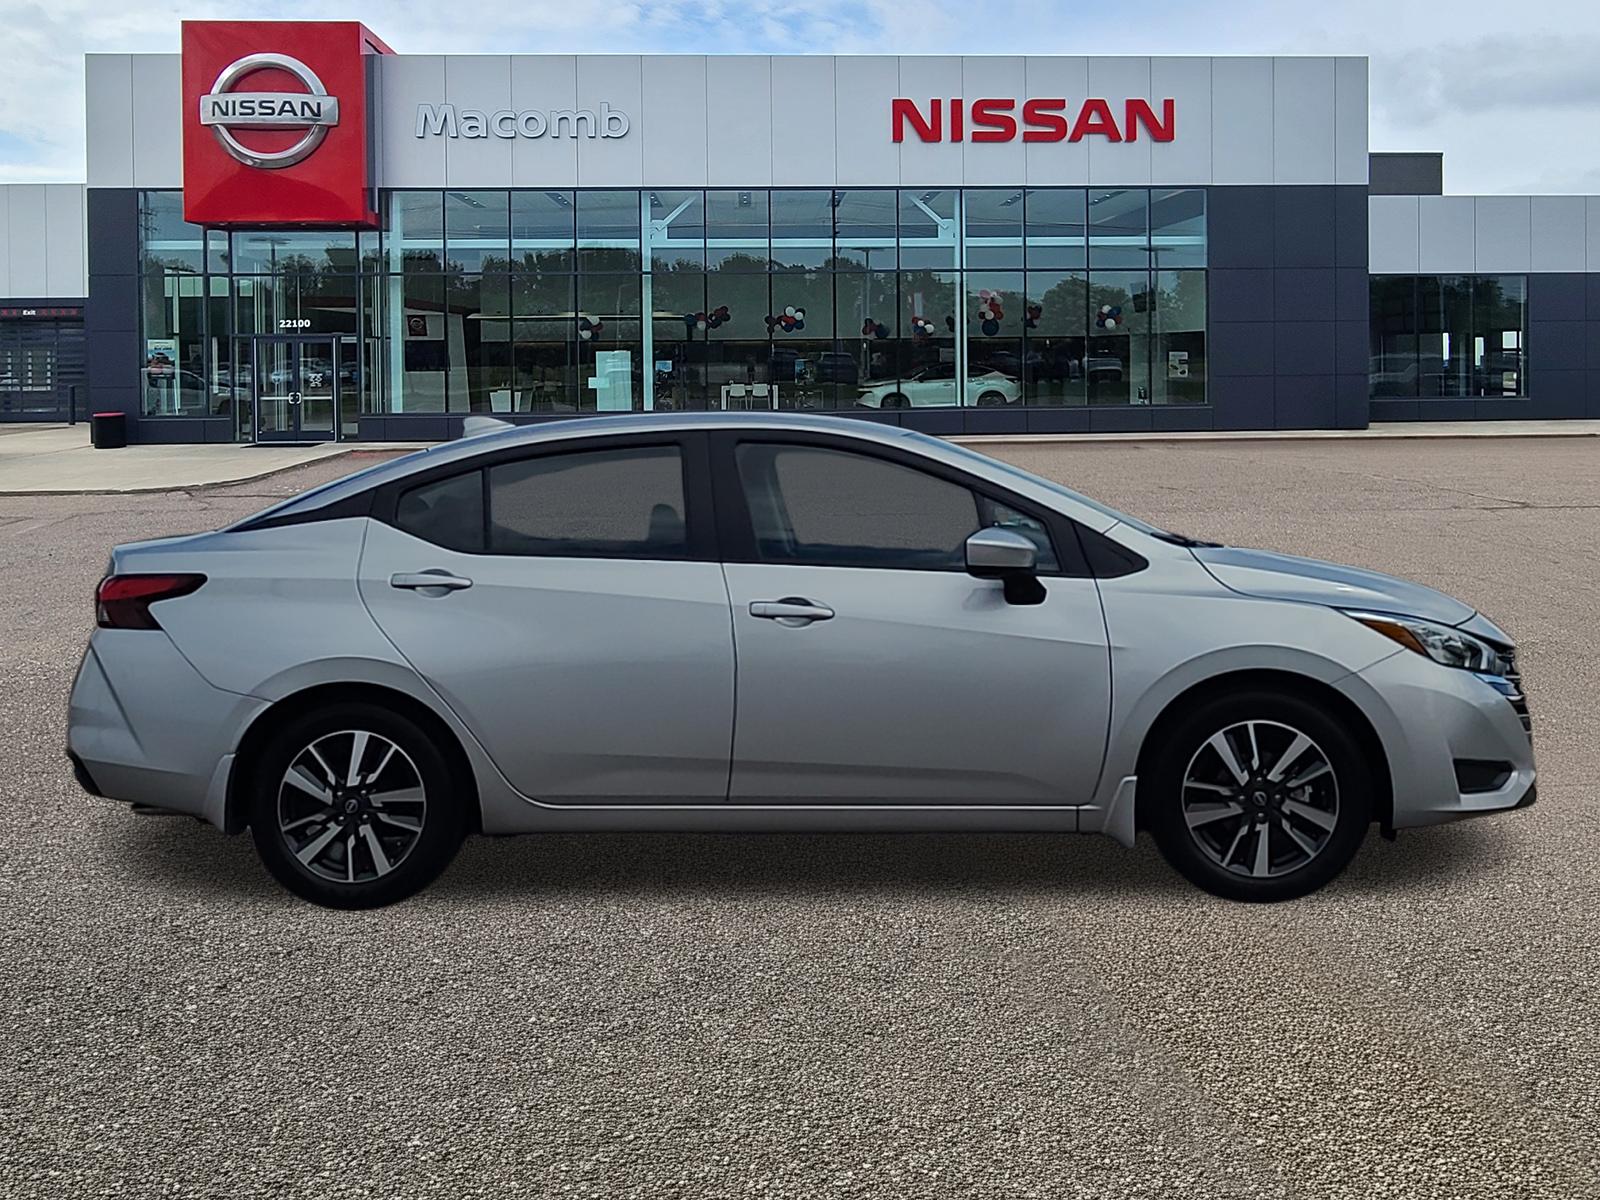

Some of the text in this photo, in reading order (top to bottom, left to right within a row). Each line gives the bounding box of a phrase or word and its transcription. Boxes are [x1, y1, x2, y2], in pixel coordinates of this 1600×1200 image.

[211, 100, 323, 118] NISSAN
[415, 101, 631, 139] Macomb
[891, 98, 1176, 143] NISSAN
[279, 319, 311, 328] 22100
